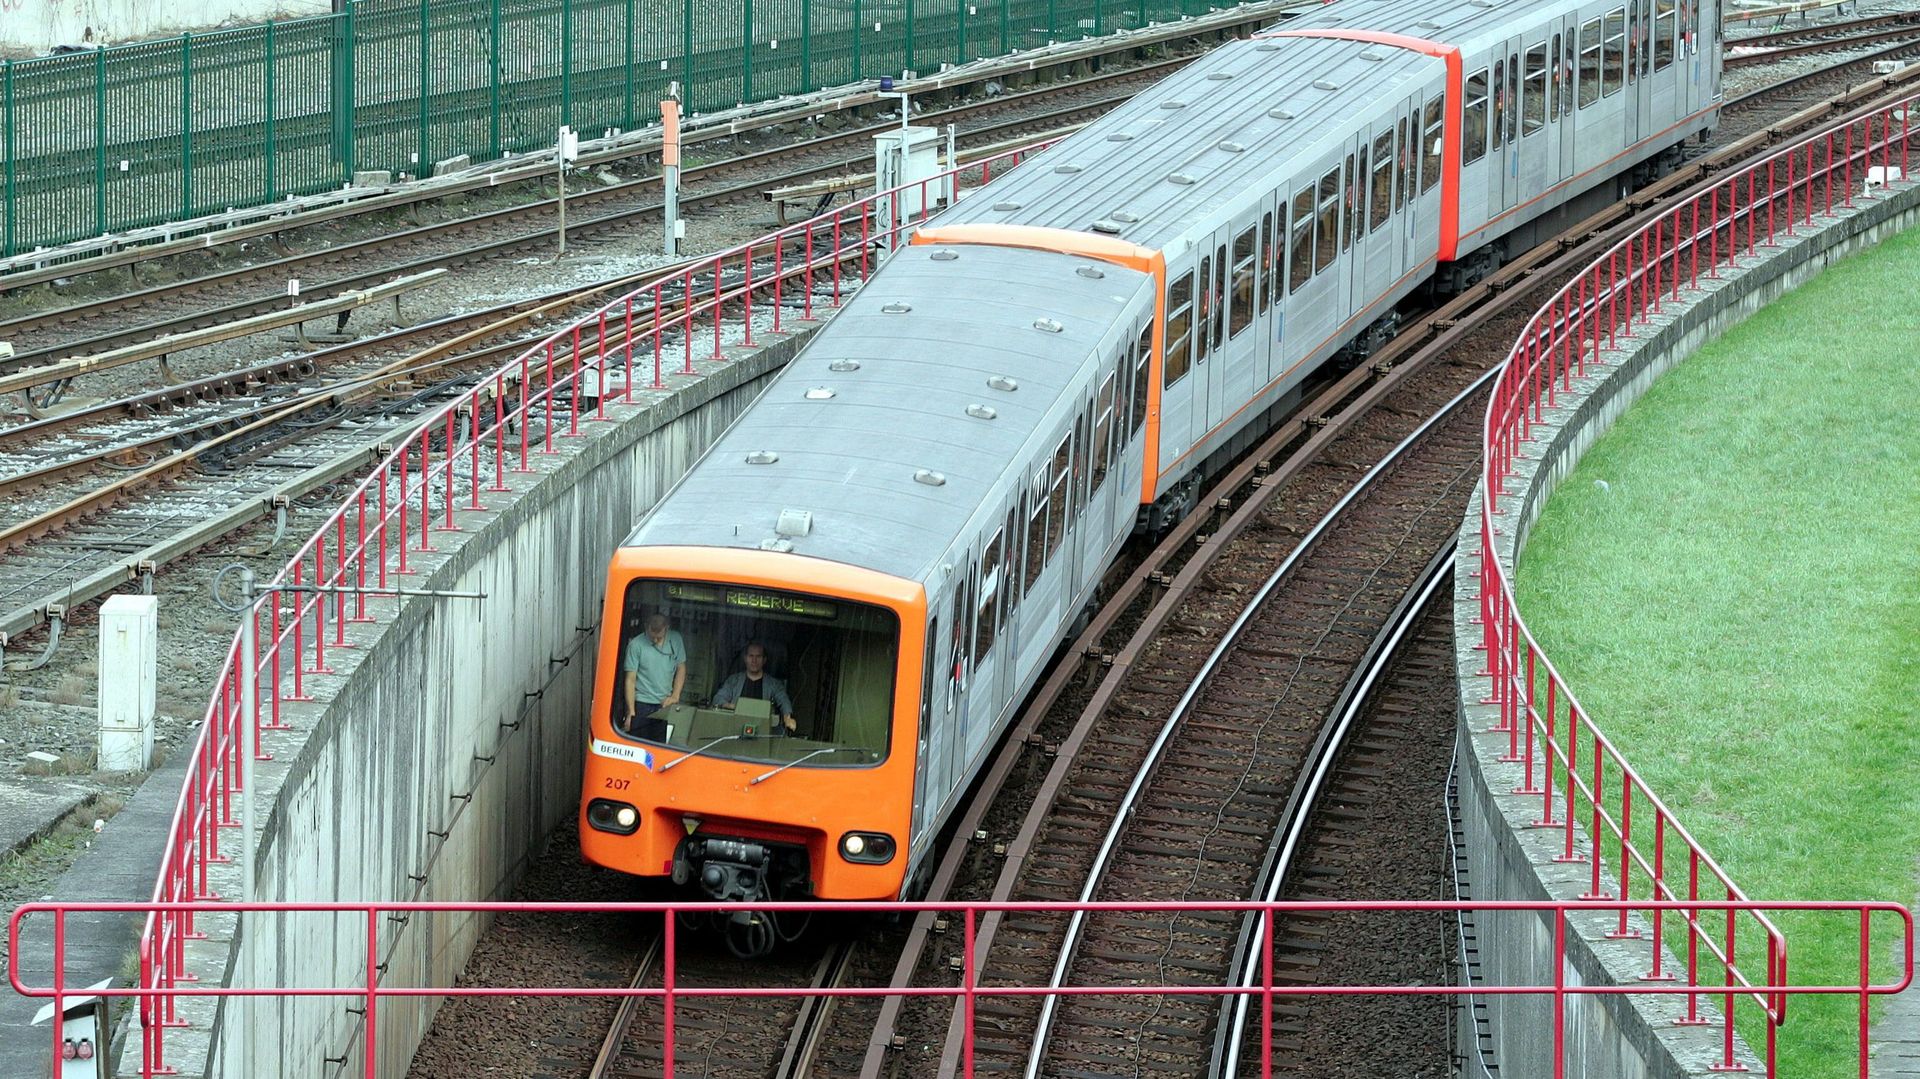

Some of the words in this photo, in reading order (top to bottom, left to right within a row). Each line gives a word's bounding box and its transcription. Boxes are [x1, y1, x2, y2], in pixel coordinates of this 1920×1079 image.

[727, 591, 803, 612] RESERVE
[600, 744, 634, 757] BERLIN
[605, 777, 631, 790] 207
